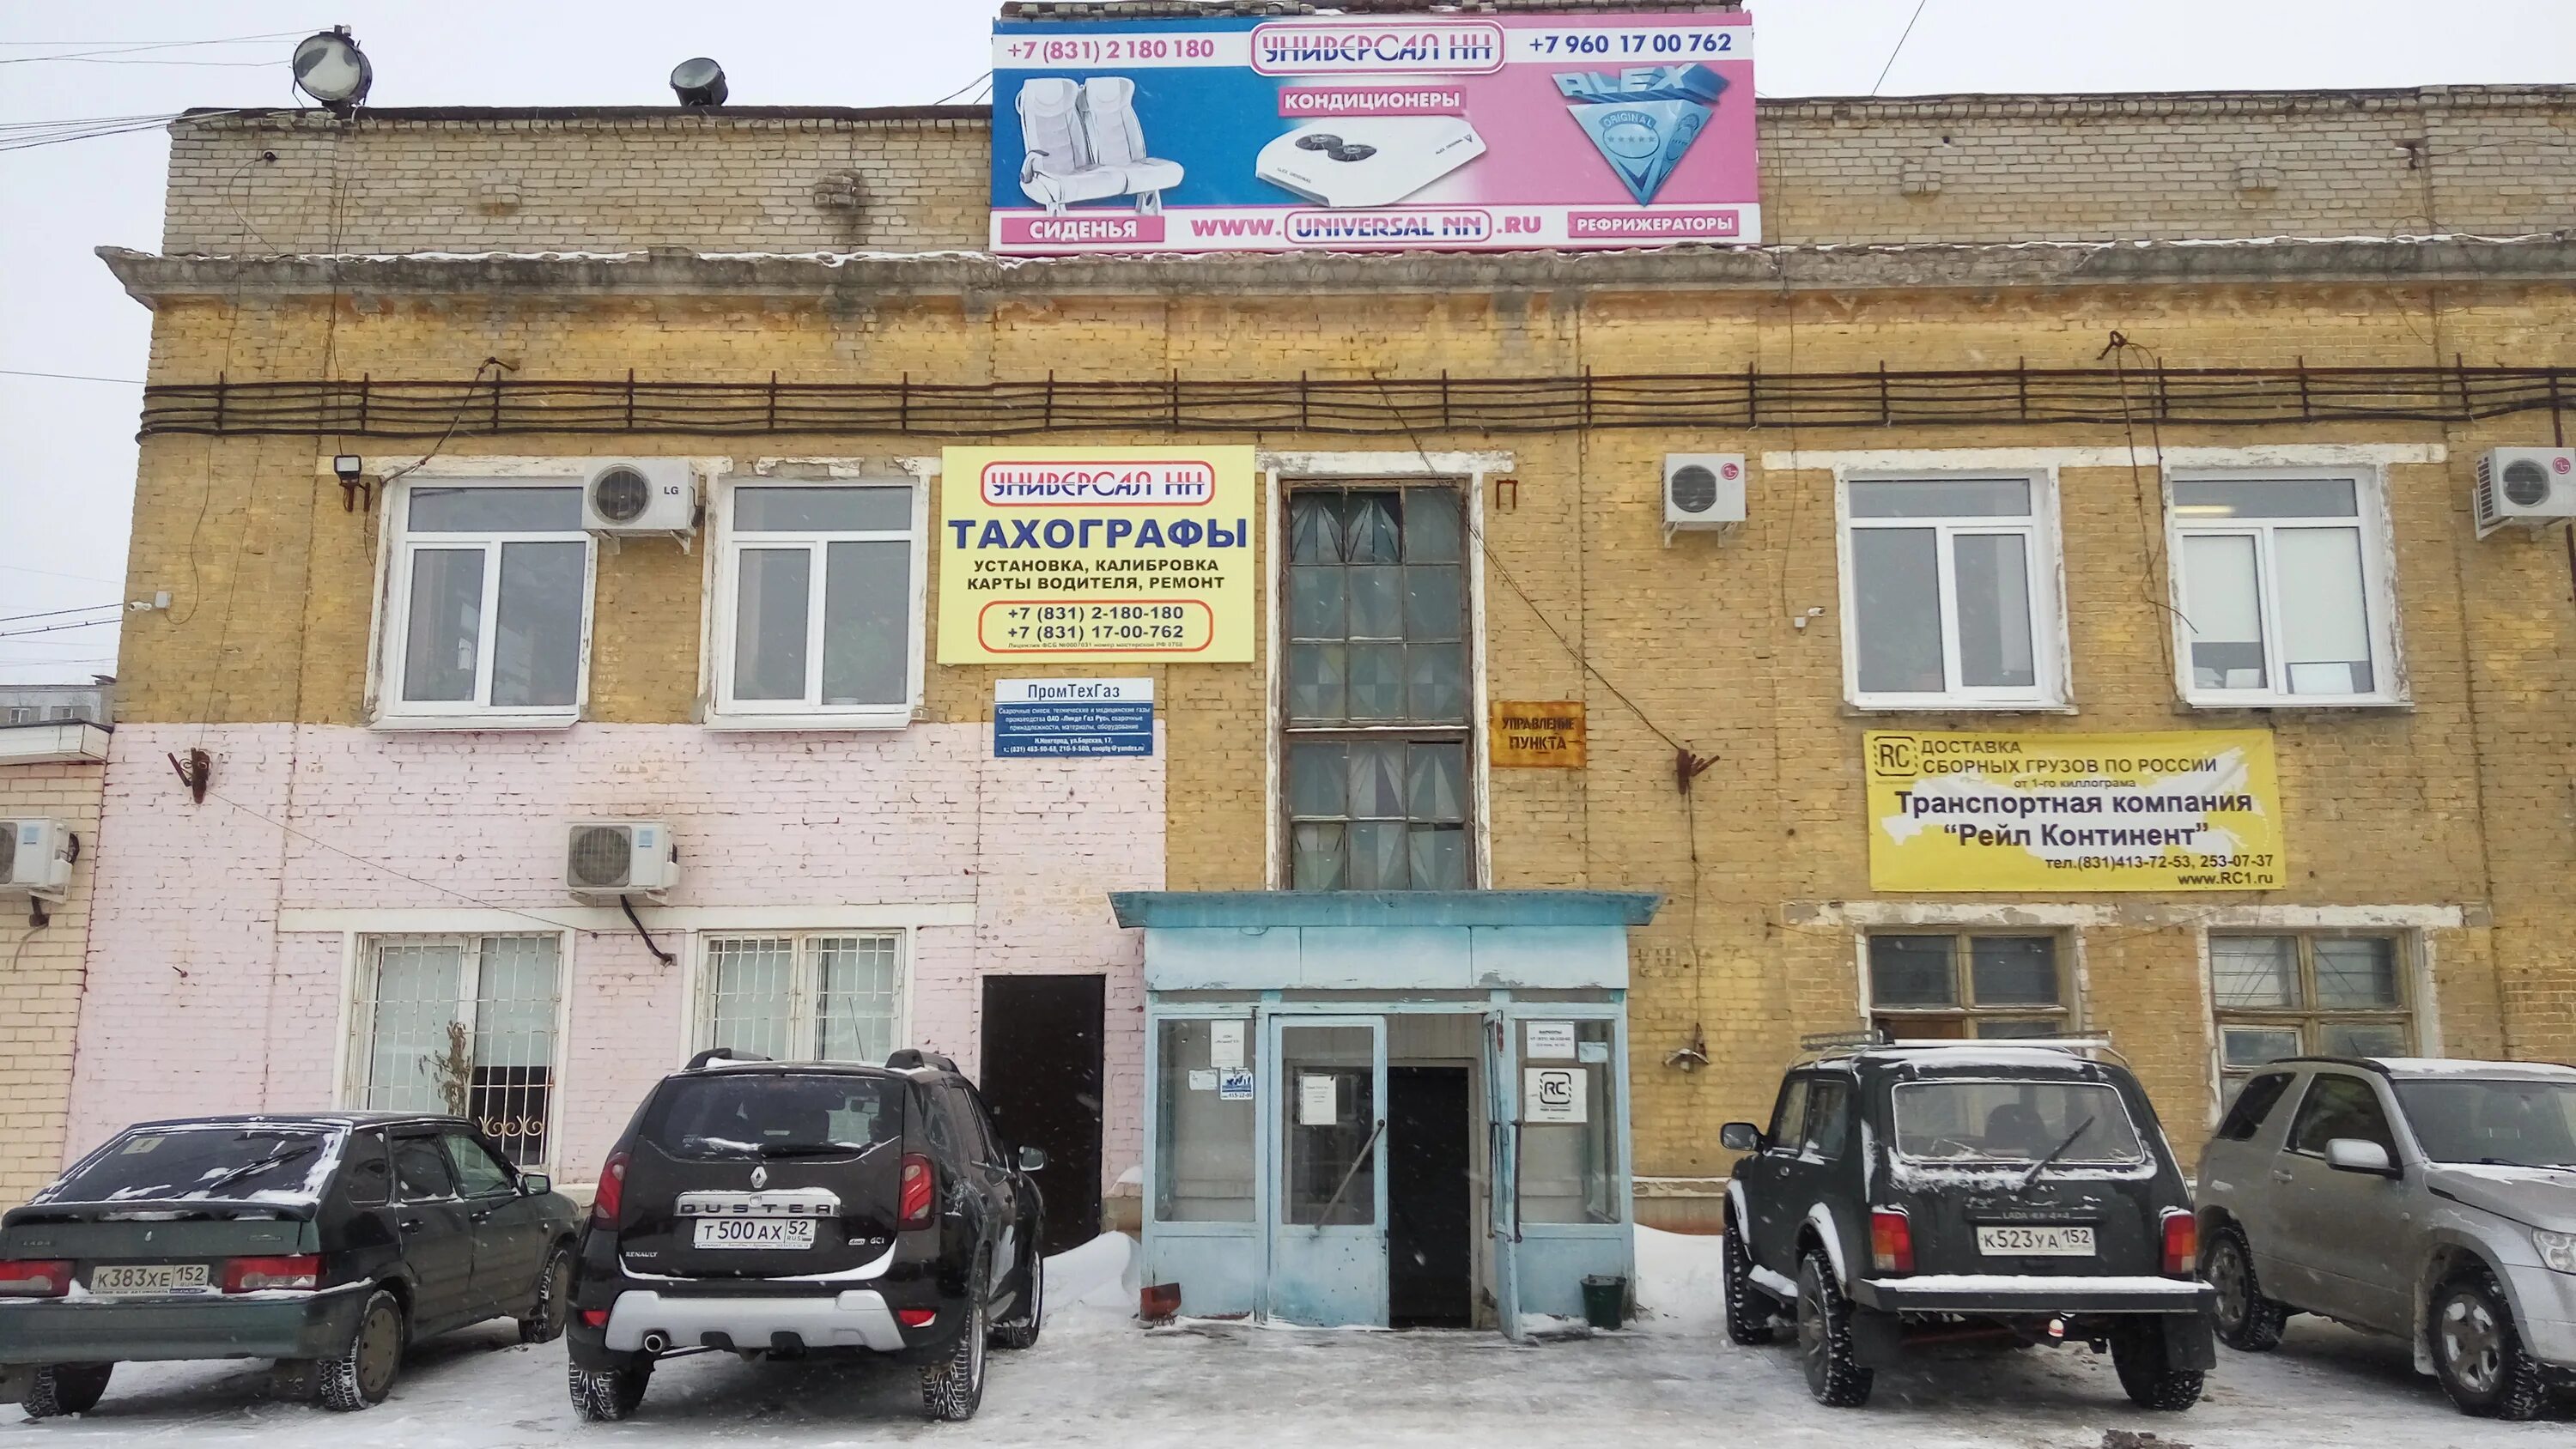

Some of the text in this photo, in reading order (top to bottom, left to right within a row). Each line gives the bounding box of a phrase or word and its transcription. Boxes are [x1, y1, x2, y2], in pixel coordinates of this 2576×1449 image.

[1262, 33, 1493, 63] УНИВЕРСАЛ НН
[1529, 33, 1732, 53] +7 960 17 00 762
[1007, 39, 1214, 64] +7 (831) 2 180 180
[1552, 63, 1704, 98] ALEX
[1285, 91, 1460, 111] КОНДИЦИОНЕРЫ
[1603, 112, 1655, 127] ORIGINAL
[1029, 219, 1138, 240] СИДЕНЬЯ
[1190, 215, 1542, 237] WWW. UNIVERSAL NN .RU
[1576, 216, 1733, 232] РЕФРИЖЕРАТОРЫ
[663, 486, 679, 495] LG
[991, 470, 1205, 497] УНИВЕРСАЛ НН
[948, 518, 1247, 549] ТАХОГРАФЫ
[973, 559, 1219, 574] УСТАНОВКА, КАЛИБРОВКА
[967, 576, 1224, 591] КАРТЫ ВОДИТЕЛЯ, РЕМОНТ
[1008, 606, 1184, 623] +7 (831) 2-180-180
[1008, 625, 1184, 643] +7 (831) 17-00-762
[1028, 683, 1121, 700] ПромТехГаз
[1509, 736, 1567, 750] ПУНКТА
[1921, 740, 2023, 756] ДОСТАВКА
[1880, 743, 1911, 768] RC
[1923, 758, 2217, 773] СБОРНЫХ ГРУЗОВ ПО РОССИИ
[2014, 779, 2027, 788] от
[2032, 778, 2057, 788] 1-го
[1895, 790, 2252, 818] Транспортная компания
[2200, 854, 2274, 869] 253-07-37
[2178, 871, 2274, 886] www.RC1.ru
[1544, 1082, 1567, 1095] RC
[680, 1203, 831, 1213] DUSTER
[788, 1221, 808, 1234] 52
[2062, 1229, 2089, 1243] 152
[176, 1266, 204, 1281] 152
